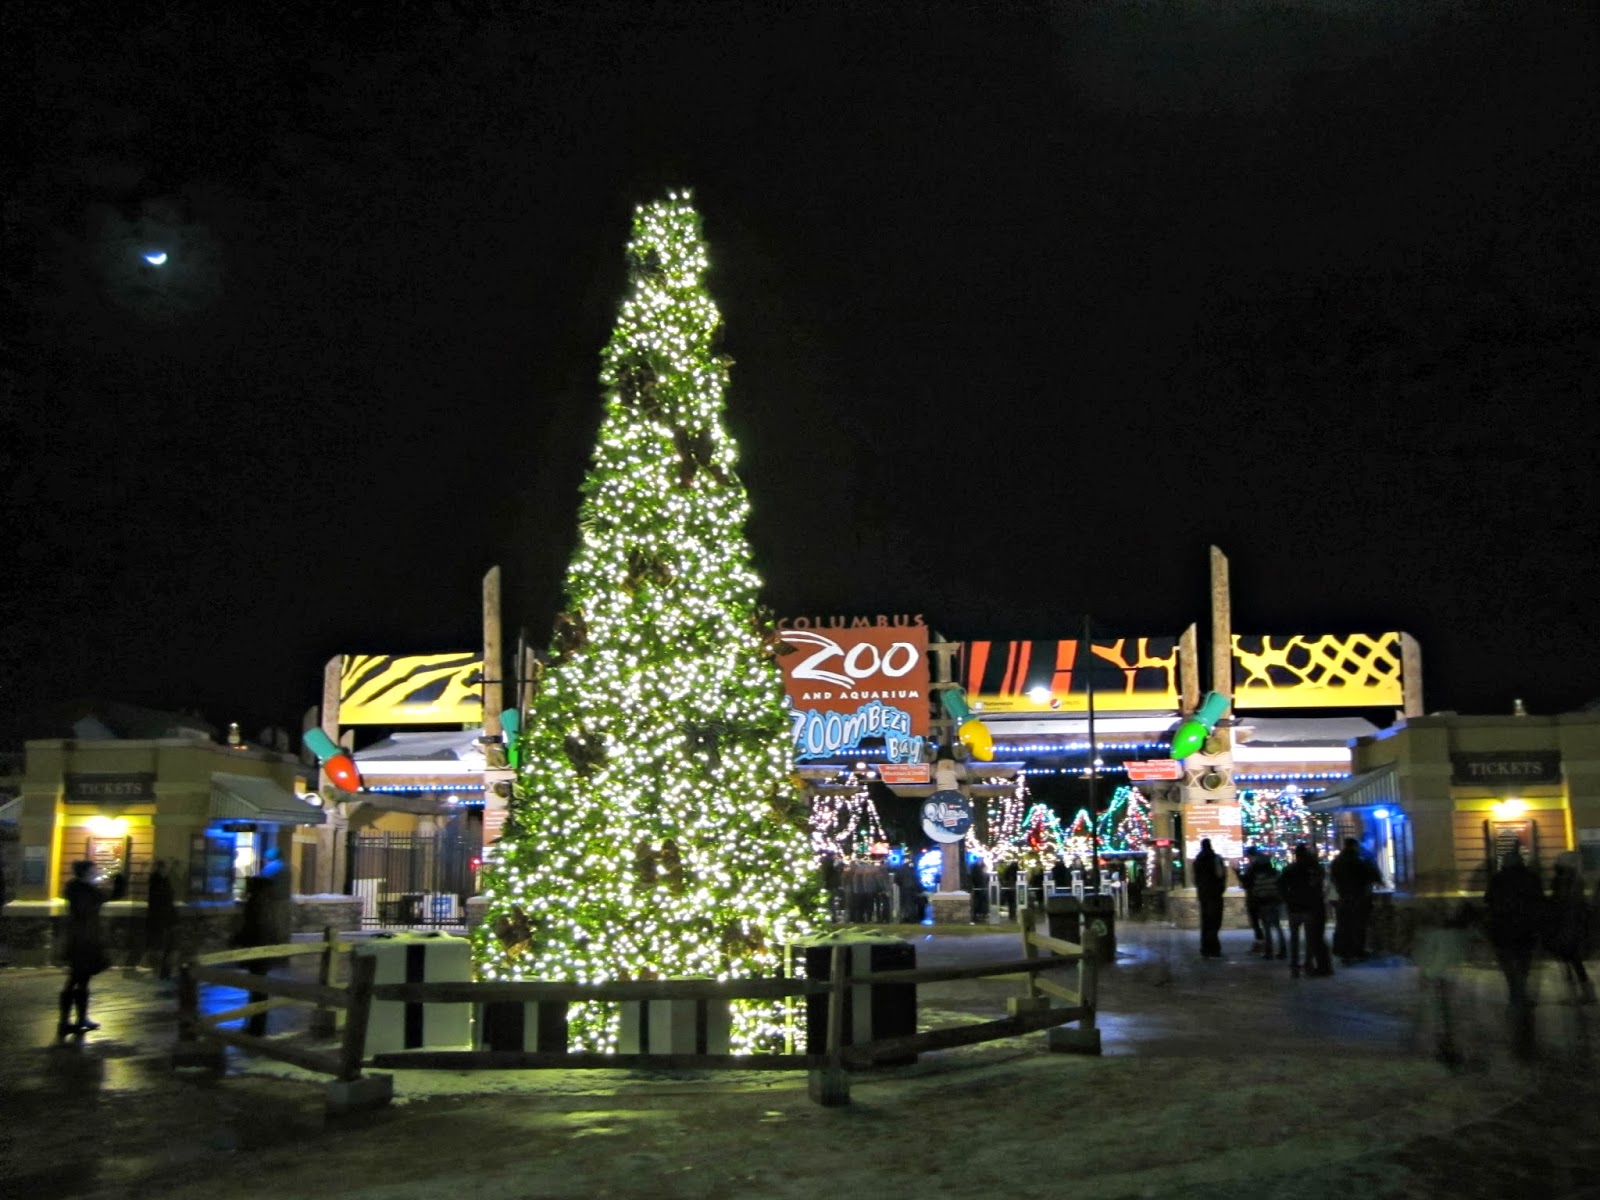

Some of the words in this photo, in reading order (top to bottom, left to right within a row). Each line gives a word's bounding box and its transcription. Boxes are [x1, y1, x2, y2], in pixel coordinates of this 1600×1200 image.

[777, 614, 925, 630] COLUMBUS
[802, 692, 833, 700] AND
[839, 690, 919, 699] AQUARIUM
[1468, 761, 1543, 776] TICKETS
[79, 782, 143, 795] TICKETS
